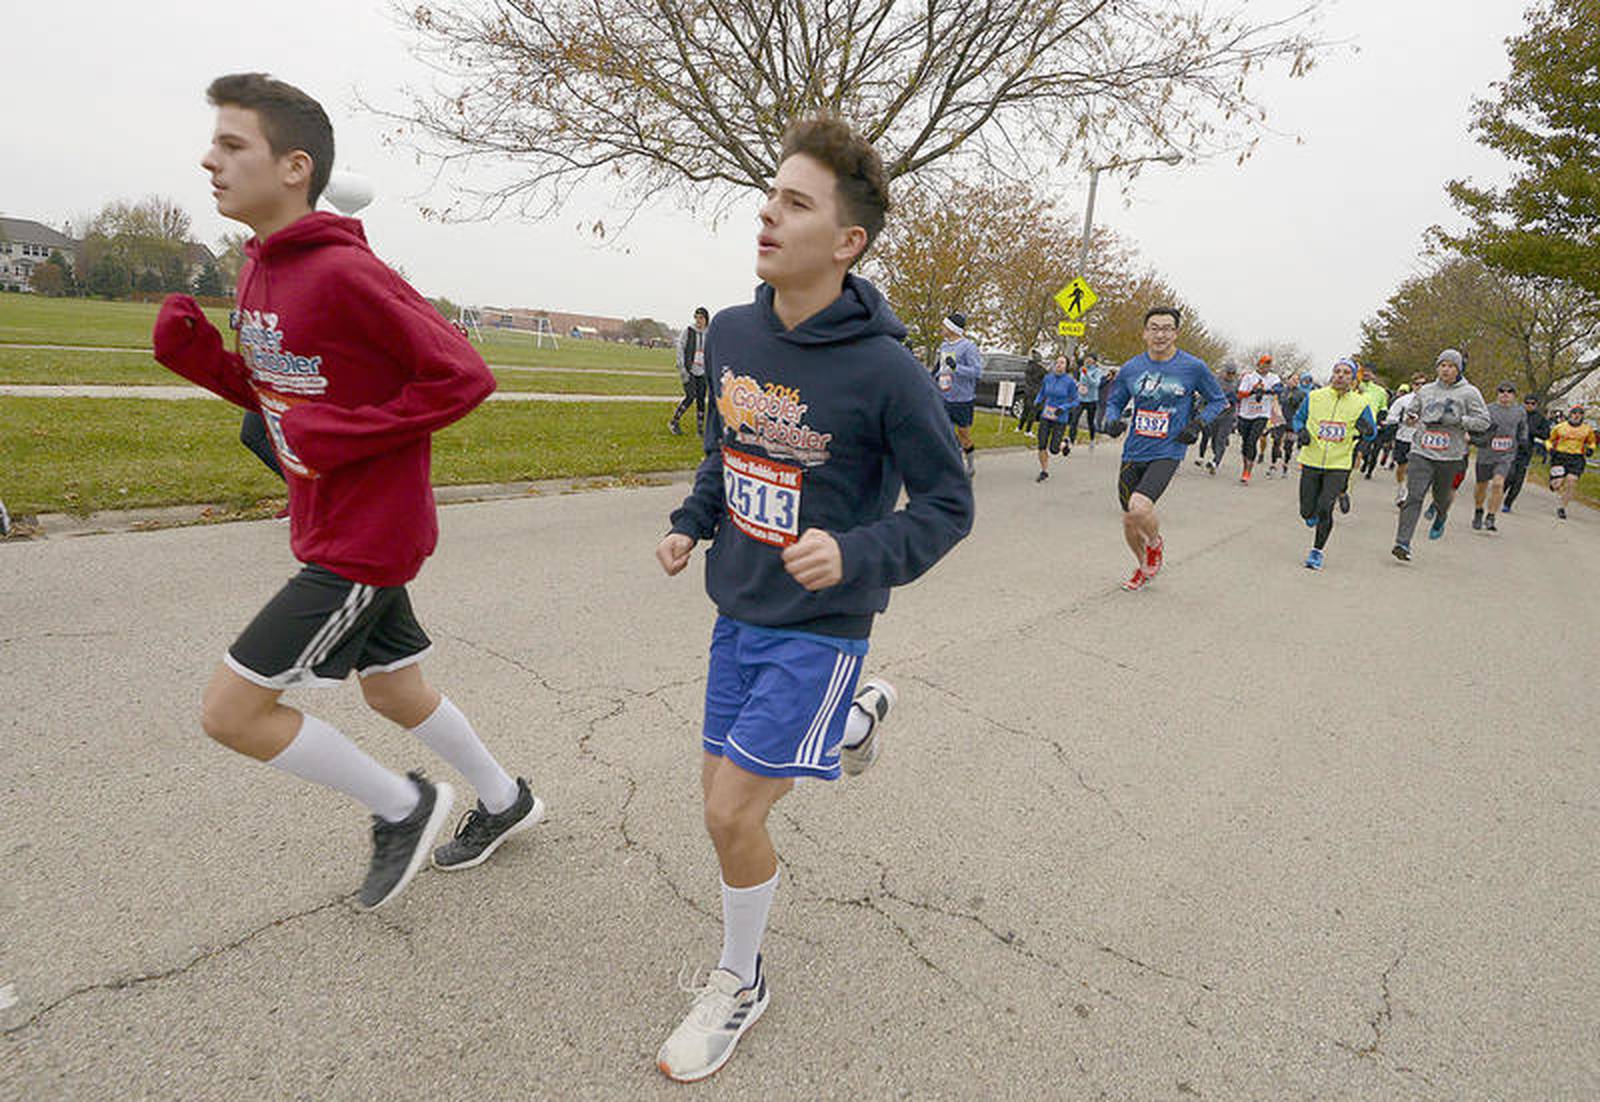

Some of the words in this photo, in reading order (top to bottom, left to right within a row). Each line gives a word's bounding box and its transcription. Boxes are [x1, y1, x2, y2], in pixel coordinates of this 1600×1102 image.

[732, 385, 808, 424] Gobbler
[763, 382, 800, 405] 2016
[725, 469, 795, 530] 2513
